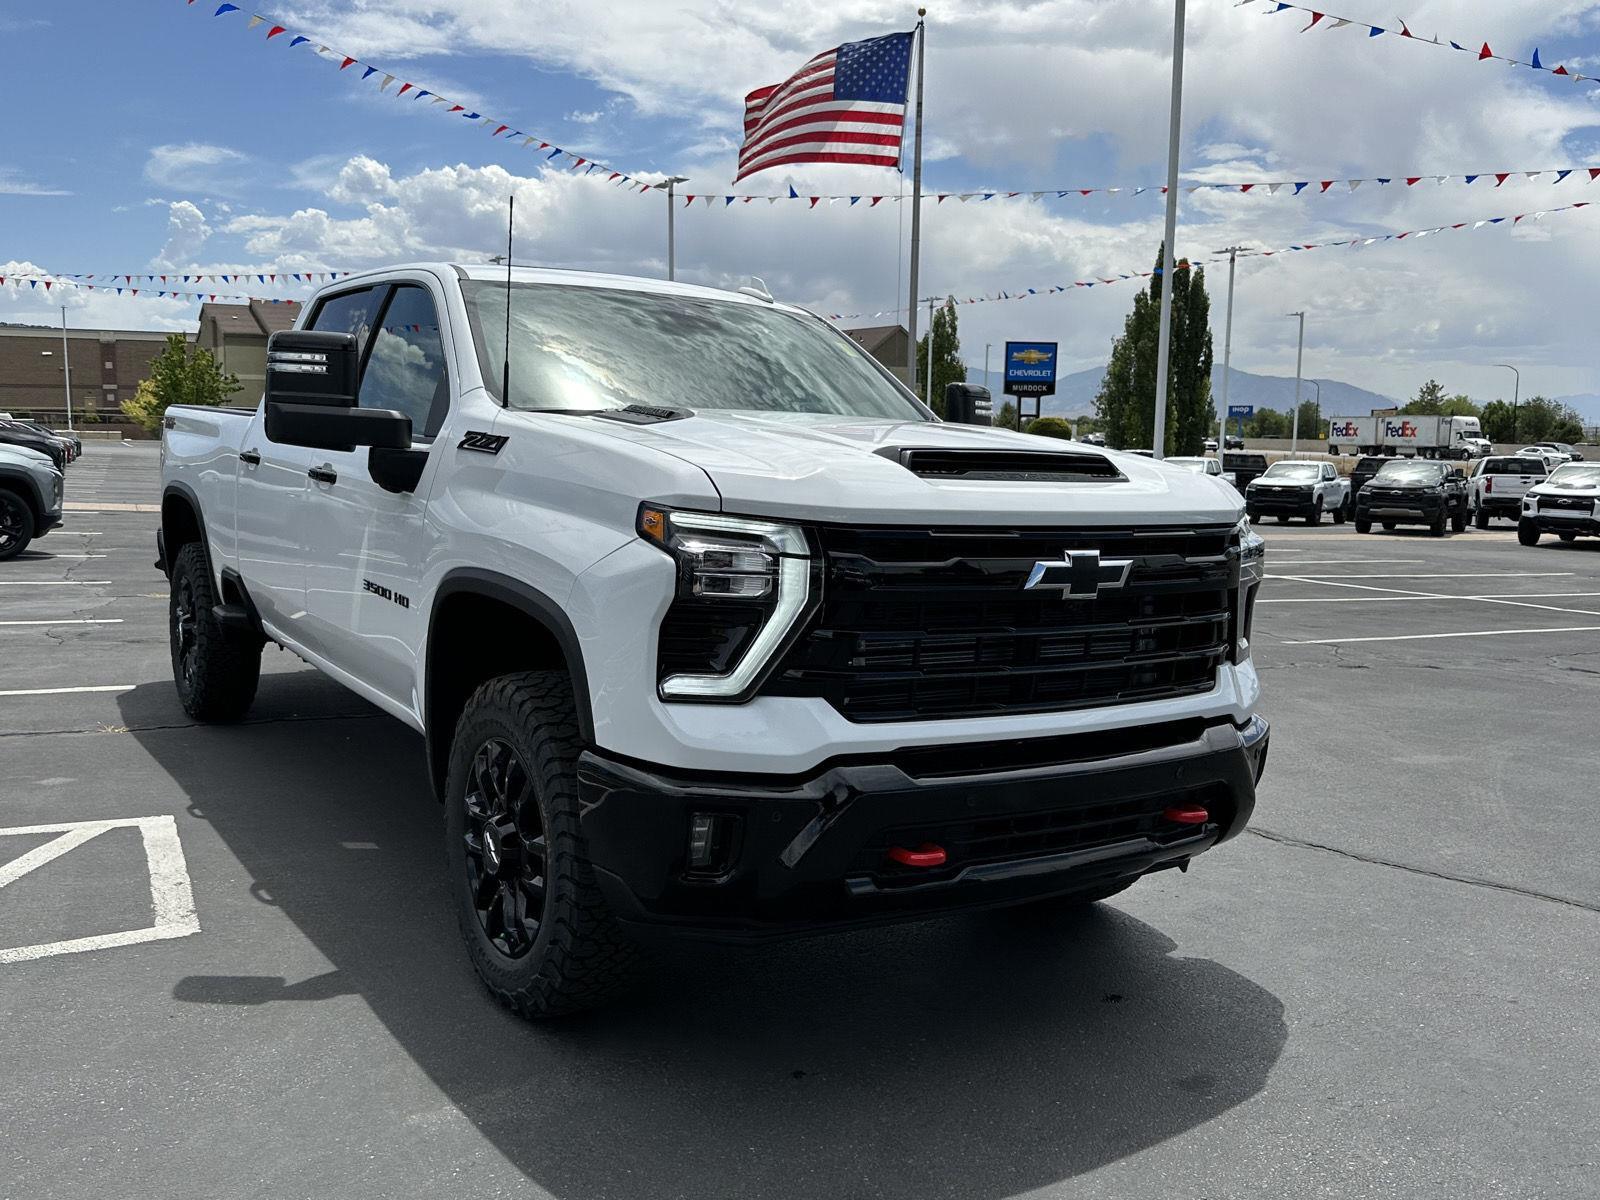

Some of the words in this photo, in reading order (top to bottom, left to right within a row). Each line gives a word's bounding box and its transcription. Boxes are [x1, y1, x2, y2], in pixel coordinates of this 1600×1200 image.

[1009, 369, 1052, 377] CHEVROLET
[1012, 384, 1047, 392] MURDOCK
[1331, 422, 1359, 438] FedEx
[1385, 421, 1417, 438] FedEx
[363, 578, 392, 601] 3500
[394, 592, 410, 608] HD
